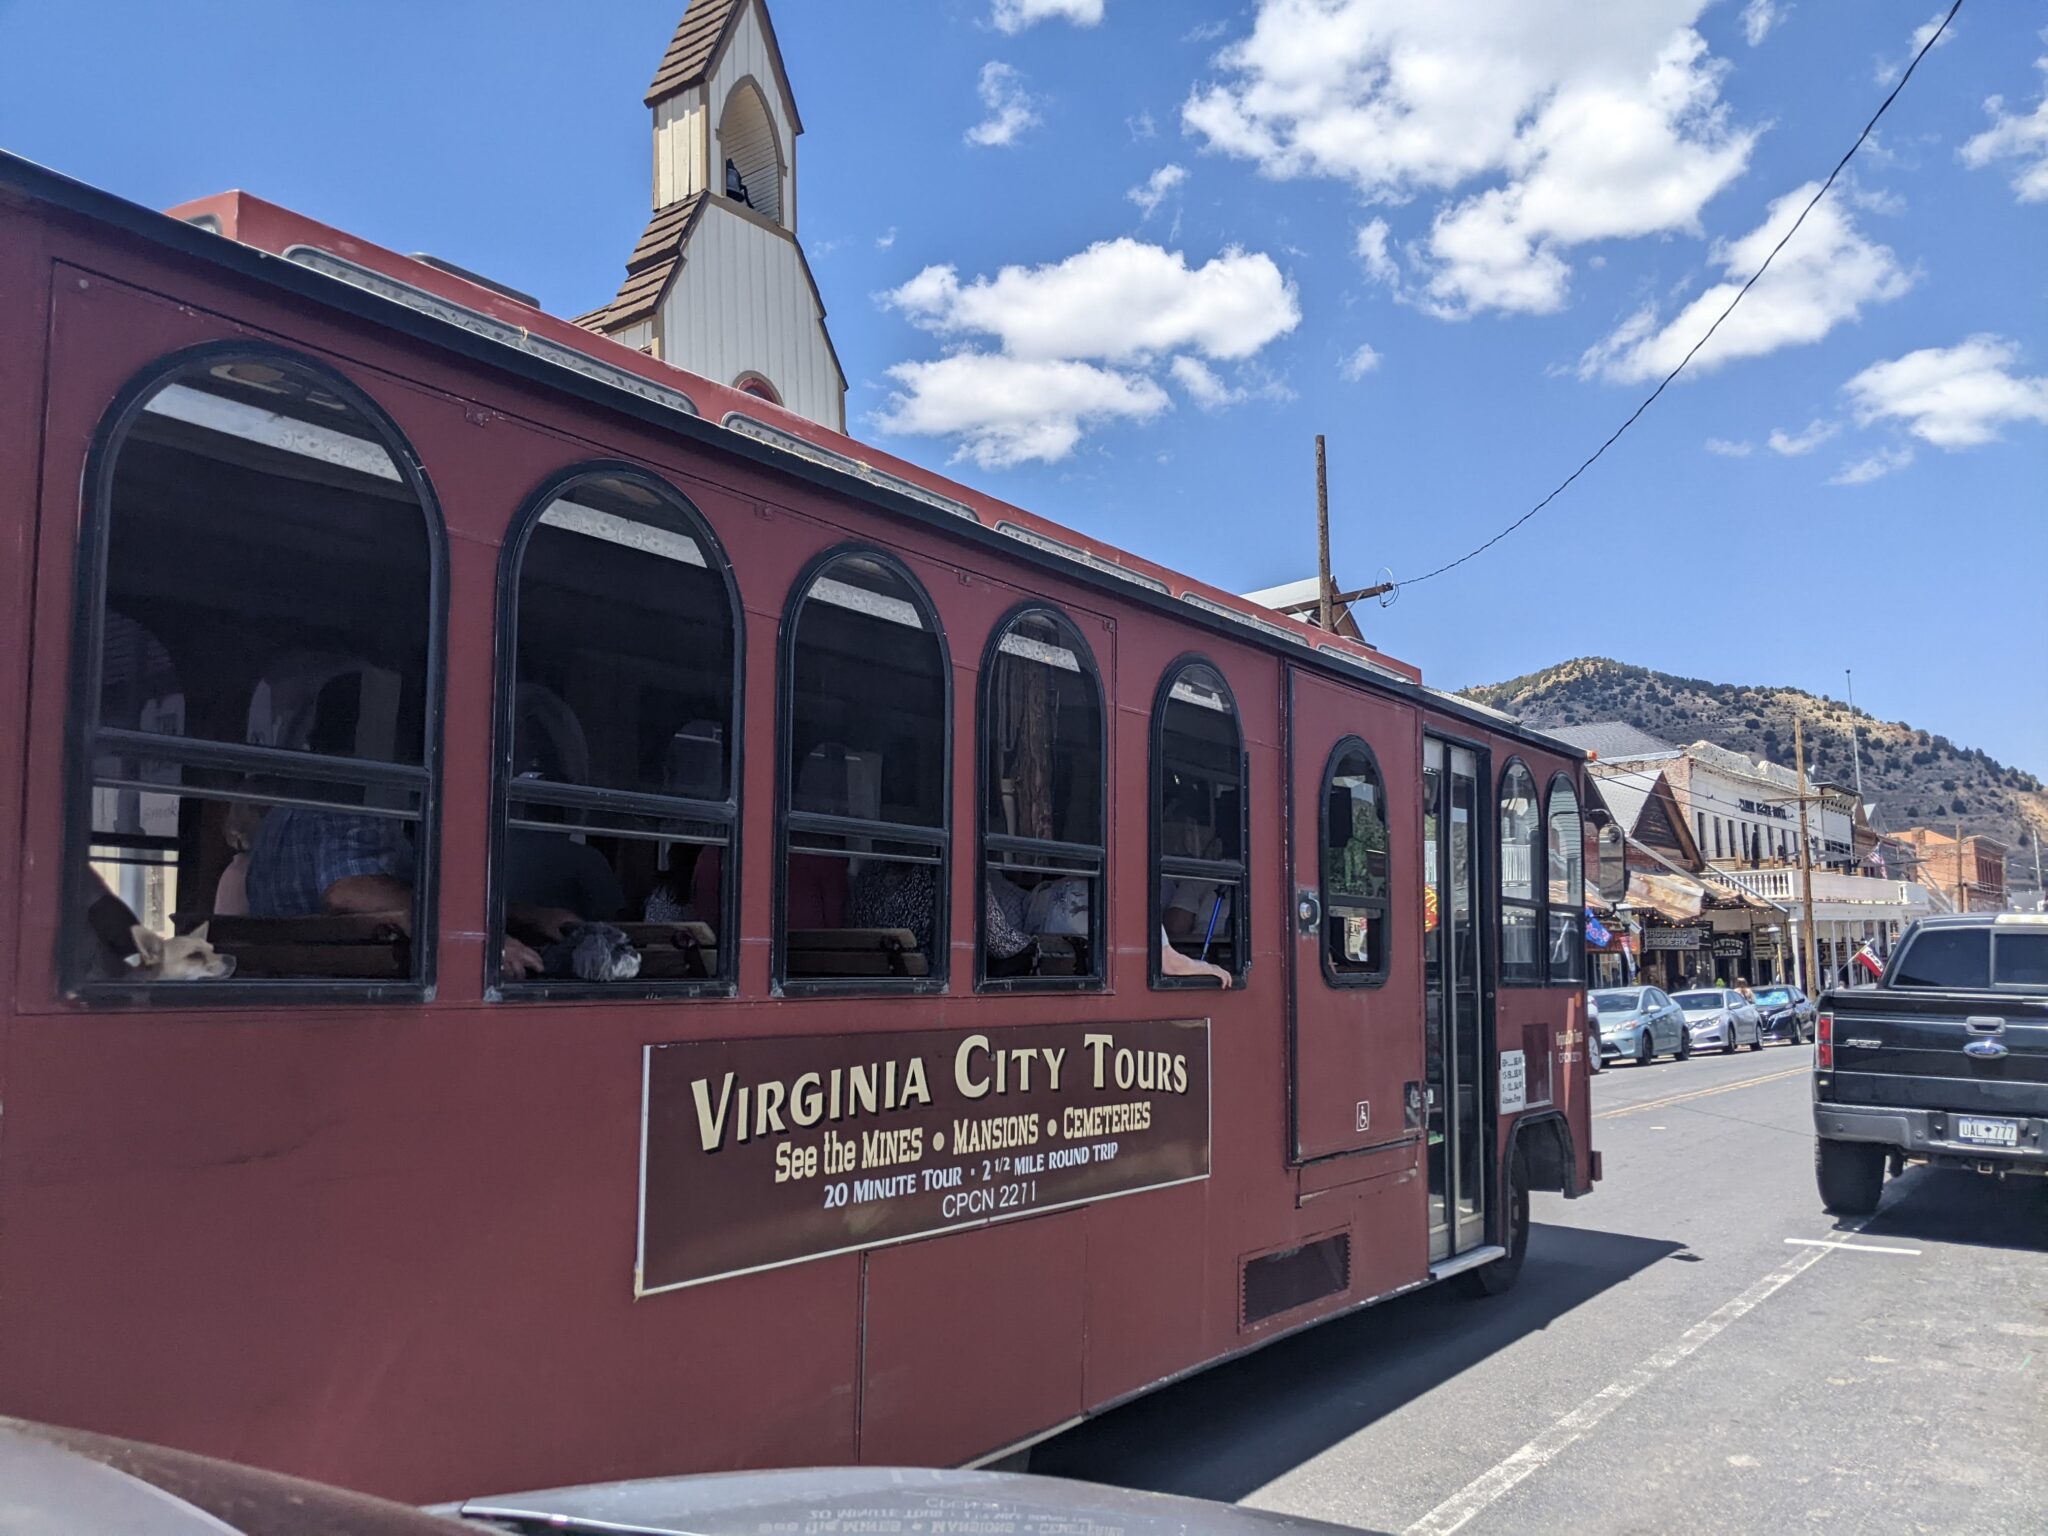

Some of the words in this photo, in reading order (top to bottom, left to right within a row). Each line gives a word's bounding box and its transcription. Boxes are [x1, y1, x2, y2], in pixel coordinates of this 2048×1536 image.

[691, 1056, 931, 1151] VIRGINIA
[954, 1034, 1065, 1098] CITY
[1083, 1033, 1188, 1094] TOURS
[775, 1141, 818, 1183] See
[824, 1130, 856, 1175] the
[861, 1127, 923, 1169] MINES
[953, 1113, 1039, 1155] MANSIONS
[1063, 1101, 1151, 1140] CEMETERIES
[1993, 1125, 2014, 1140] 777
[823, 1182, 848, 1209] 20
[853, 1173, 917, 1204] MINUTE
[921, 1166, 963, 1191] TOUR
[1014, 1153, 1045, 1177] MILE
[1048, 1146, 1090, 1170] ROUND
[1092, 1141, 1119, 1162] TRIP
[942, 1187, 994, 1218] CPCN
[999, 1180, 1036, 1208] 2271
